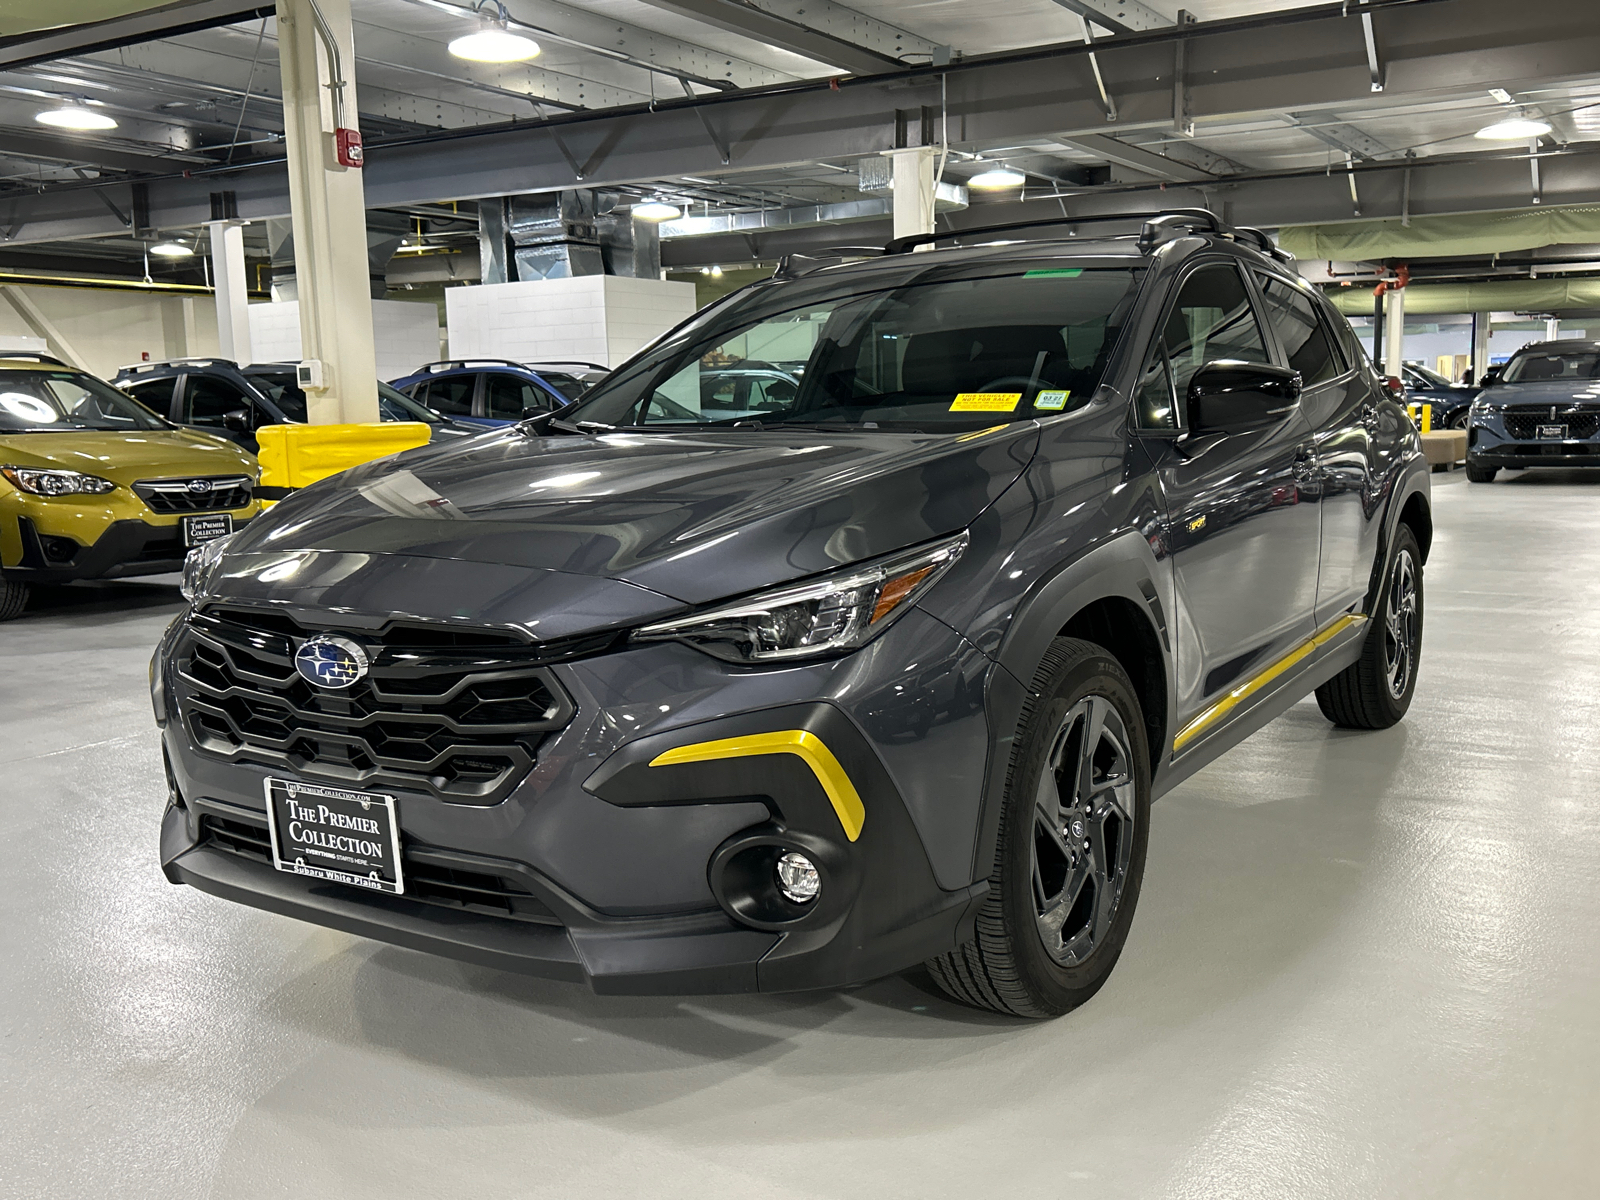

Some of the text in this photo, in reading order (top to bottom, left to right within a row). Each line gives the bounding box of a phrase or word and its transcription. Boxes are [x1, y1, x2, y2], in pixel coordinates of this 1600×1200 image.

[190, 528, 226, 537] COLLECTION
[286, 799, 380, 835] THE PREMIER
[288, 821, 383, 858] COLLECTION
[305, 848, 336, 860] EVERYTHING
[293, 865, 382, 889] Subaru White Plains
